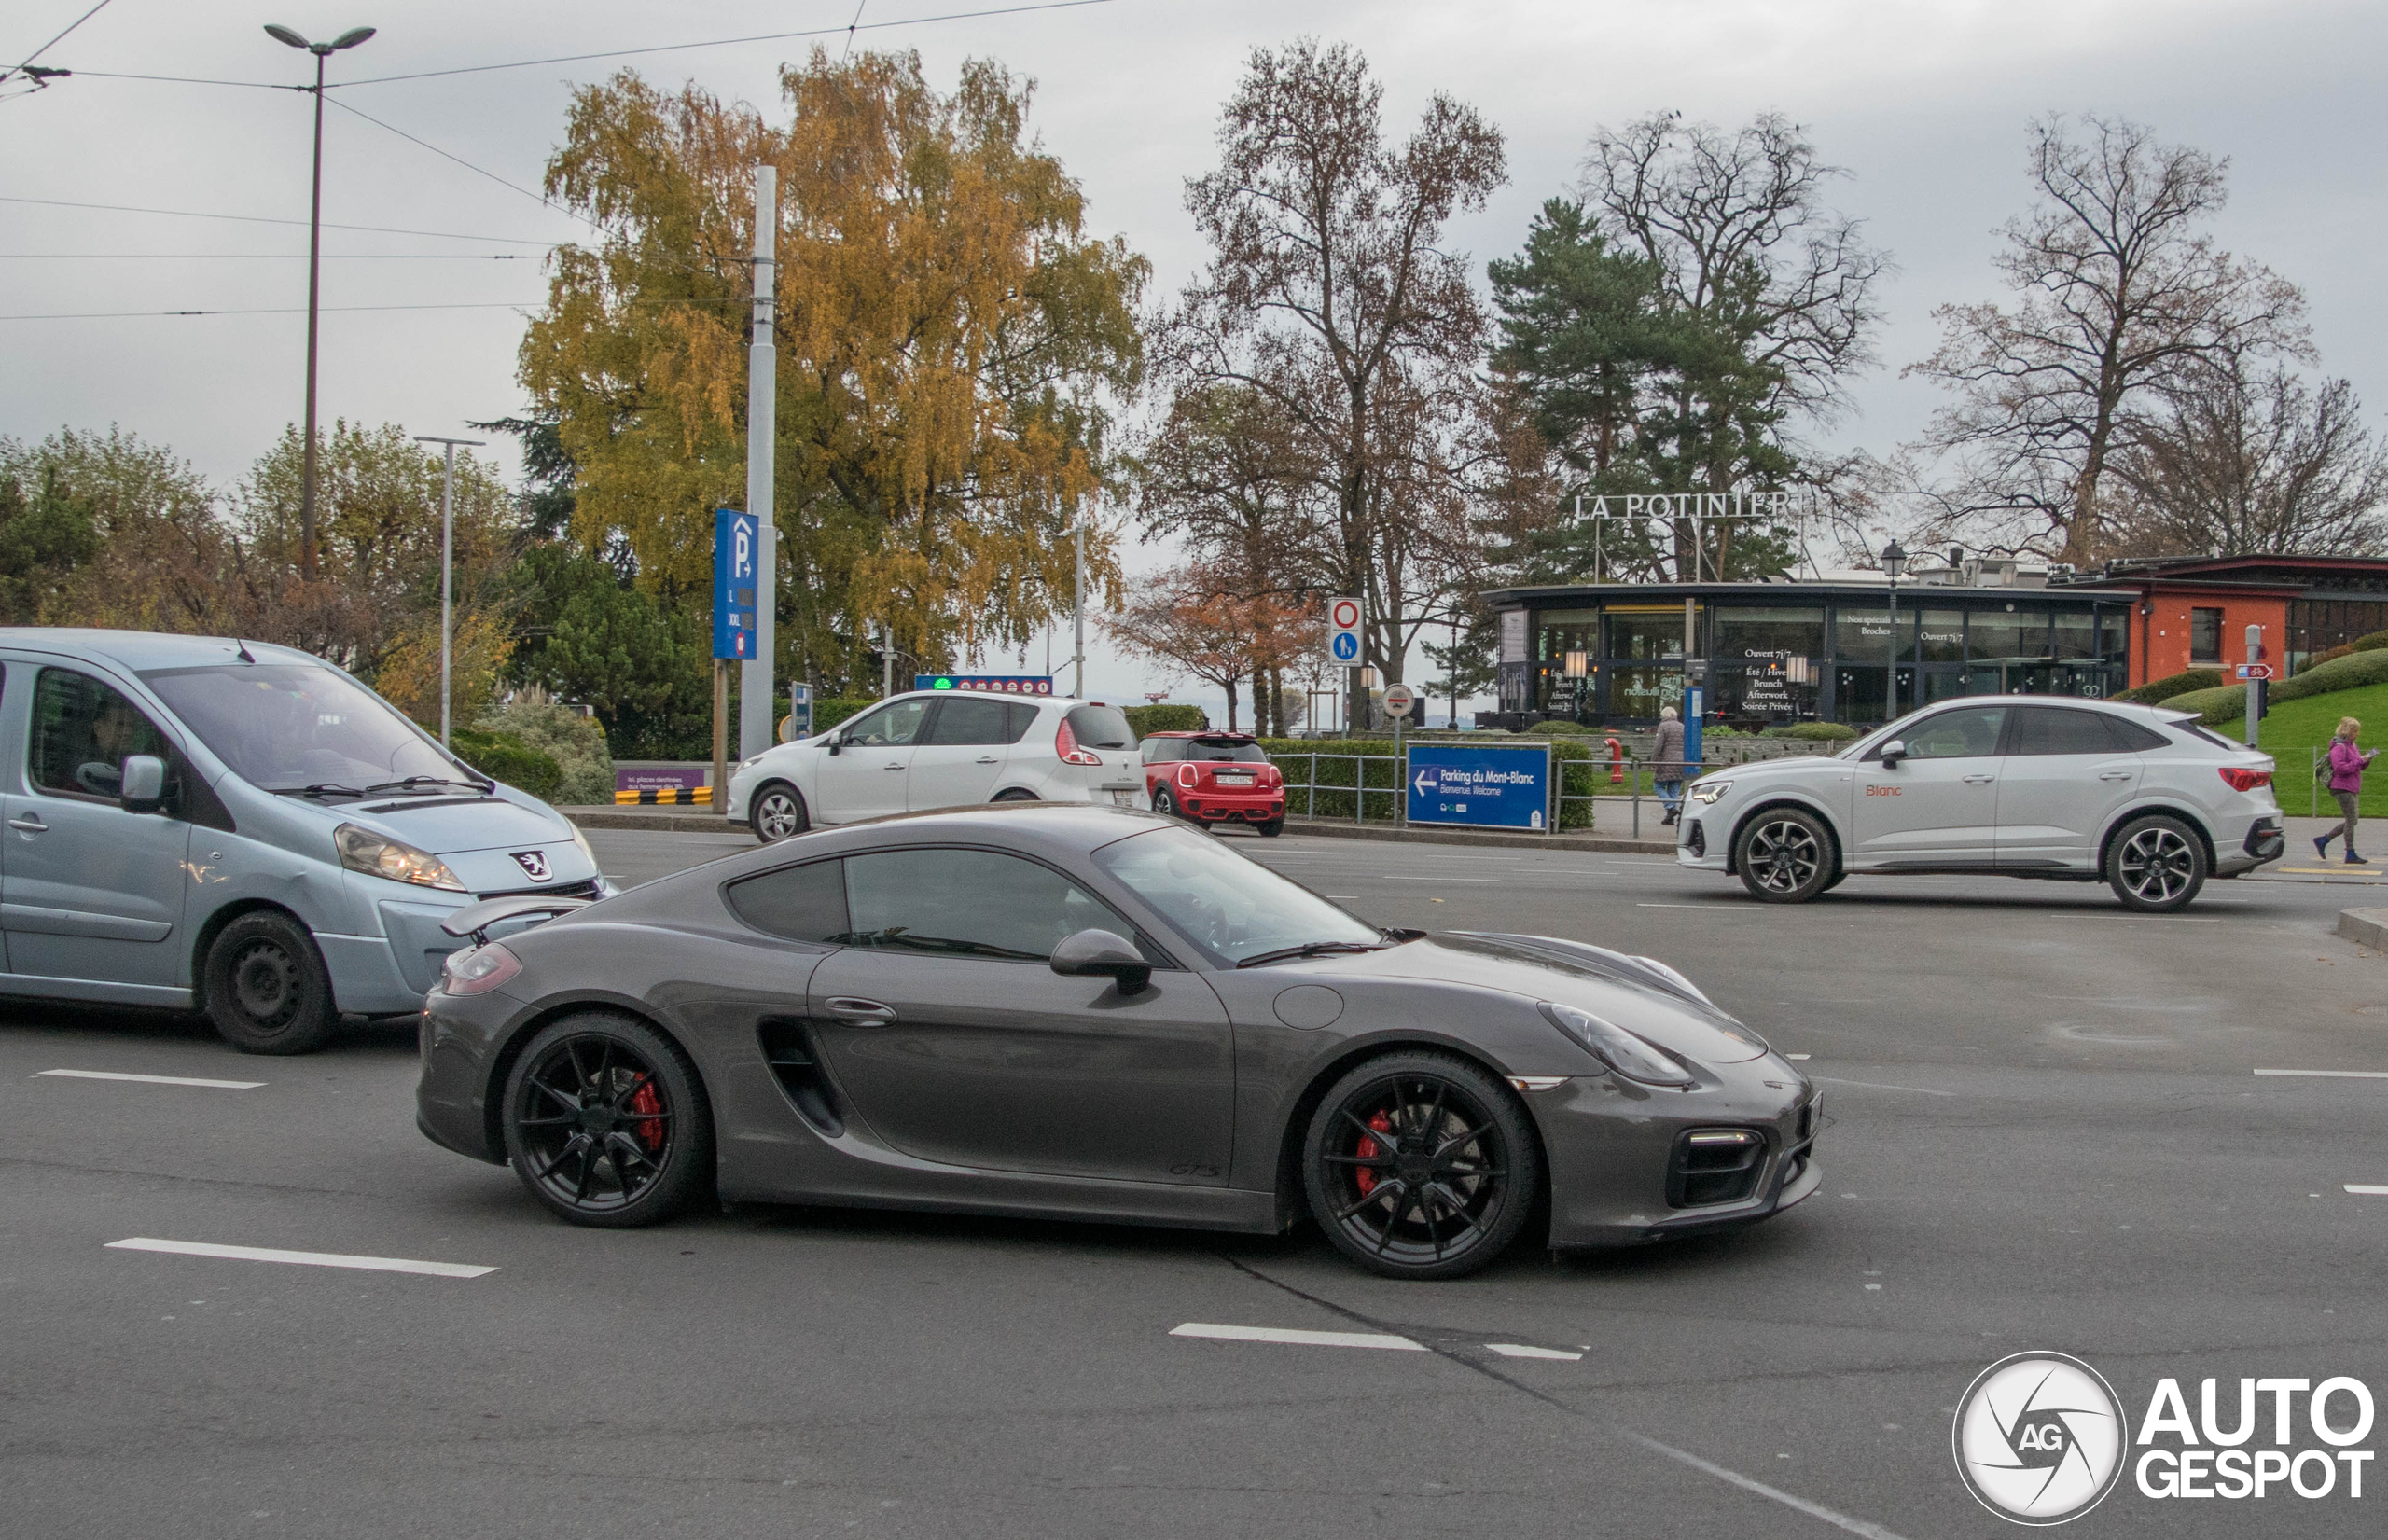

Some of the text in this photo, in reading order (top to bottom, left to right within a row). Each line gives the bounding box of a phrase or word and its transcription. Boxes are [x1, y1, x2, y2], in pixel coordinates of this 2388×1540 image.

[1575, 495, 1610, 520] LA
[735, 532, 749, 577] P
[729, 590, 733, 602] L
[729, 614, 741, 626] XXL
[1921, 632, 1964, 643] Ouvert 7j/7
[1745, 649, 1791, 659] Ouvert 7j/7
[1746, 666, 1760, 676] Été
[1768, 668, 1786, 676] Hive
[1754, 679, 1783, 687] Brunch
[1747, 690, 1788, 700] Afterwork
[1742, 701, 1793, 711] Soirée Privée
[1440, 769, 1534, 785] Parking du Mont-Blanc
[1473, 784, 1501, 796] Welcome
[1866, 785, 1902, 797] Blanc
[1170, 1163, 1219, 1177] GTS
